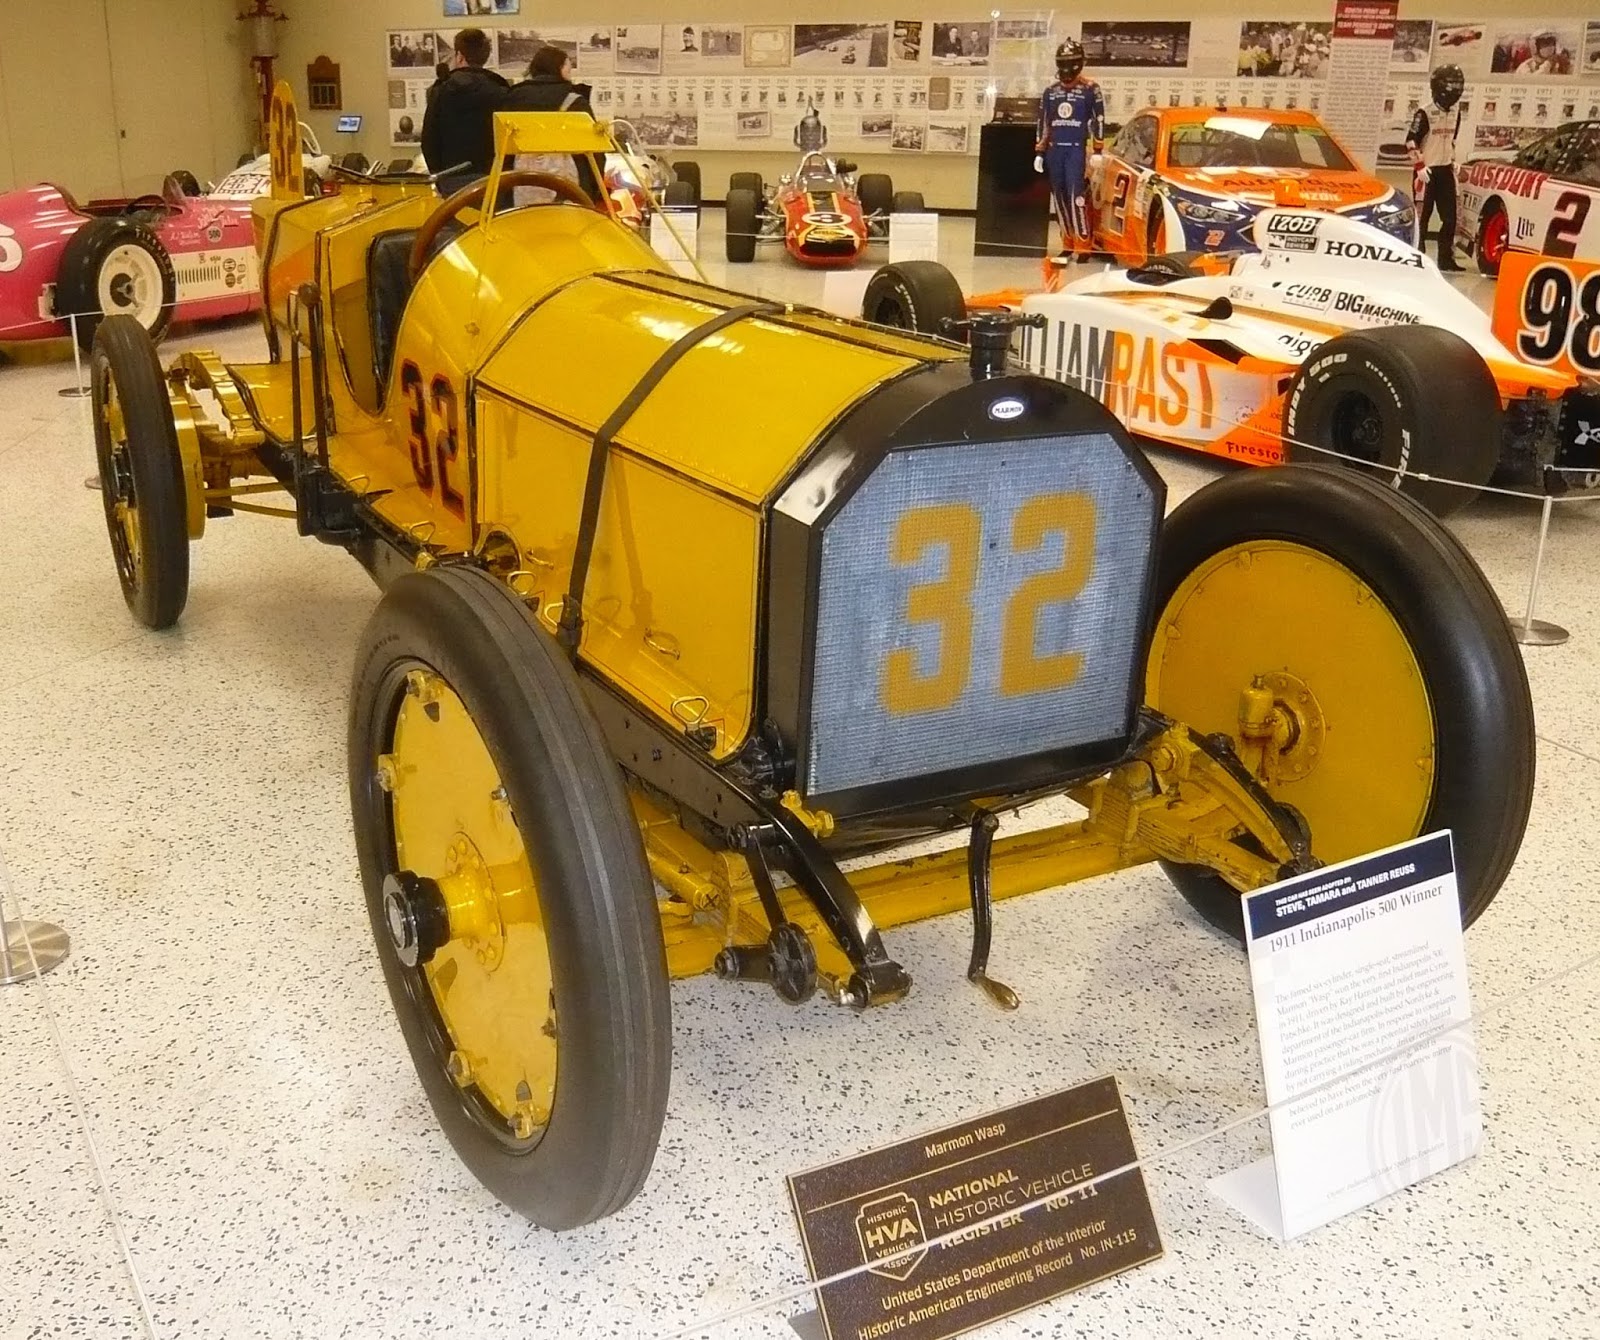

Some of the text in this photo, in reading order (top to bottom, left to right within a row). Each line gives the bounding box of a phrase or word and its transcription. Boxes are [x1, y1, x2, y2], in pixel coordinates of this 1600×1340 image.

[1470, 163, 1550, 200] DISCOUNT
[1269, 215, 1317, 233] IZOD
[1516, 217, 1535, 240] Lite
[1542, 191, 1591, 259] 2
[1335, 292, 1365, 313] BIG
[1361, 303, 1422, 325] MACHINE
[1517, 262, 1600, 375] 98
[402, 358, 466, 523] 32
[1226, 441, 1284, 462] Firesto
[880, 489, 1098, 716] 32
[1275, 862, 1415, 917] STEVE, TAMARA and TANNER REUSS
[1269, 886, 1442, 952] 1911 Indianapolis 500 Winner
[925, 1123, 1006, 1158] Marmon Wasp
[928, 1169, 1019, 1209] NATIONAL
[935, 1163, 1094, 1229] HISTORIC VEHICLE
[865, 1218, 918, 1249] HVA
[867, 1206, 907, 1225] HISTORIC
[940, 1184, 1099, 1250] REGISTER No. 11
[876, 1240, 916, 1258] VEHICLE
[882, 1219, 1106, 1310] United States Department of the Interior
[884, 1254, 915, 1269] ASSOC.
[858, 1228, 1137, 1340] Historic American Engineering Record No. IN-115
